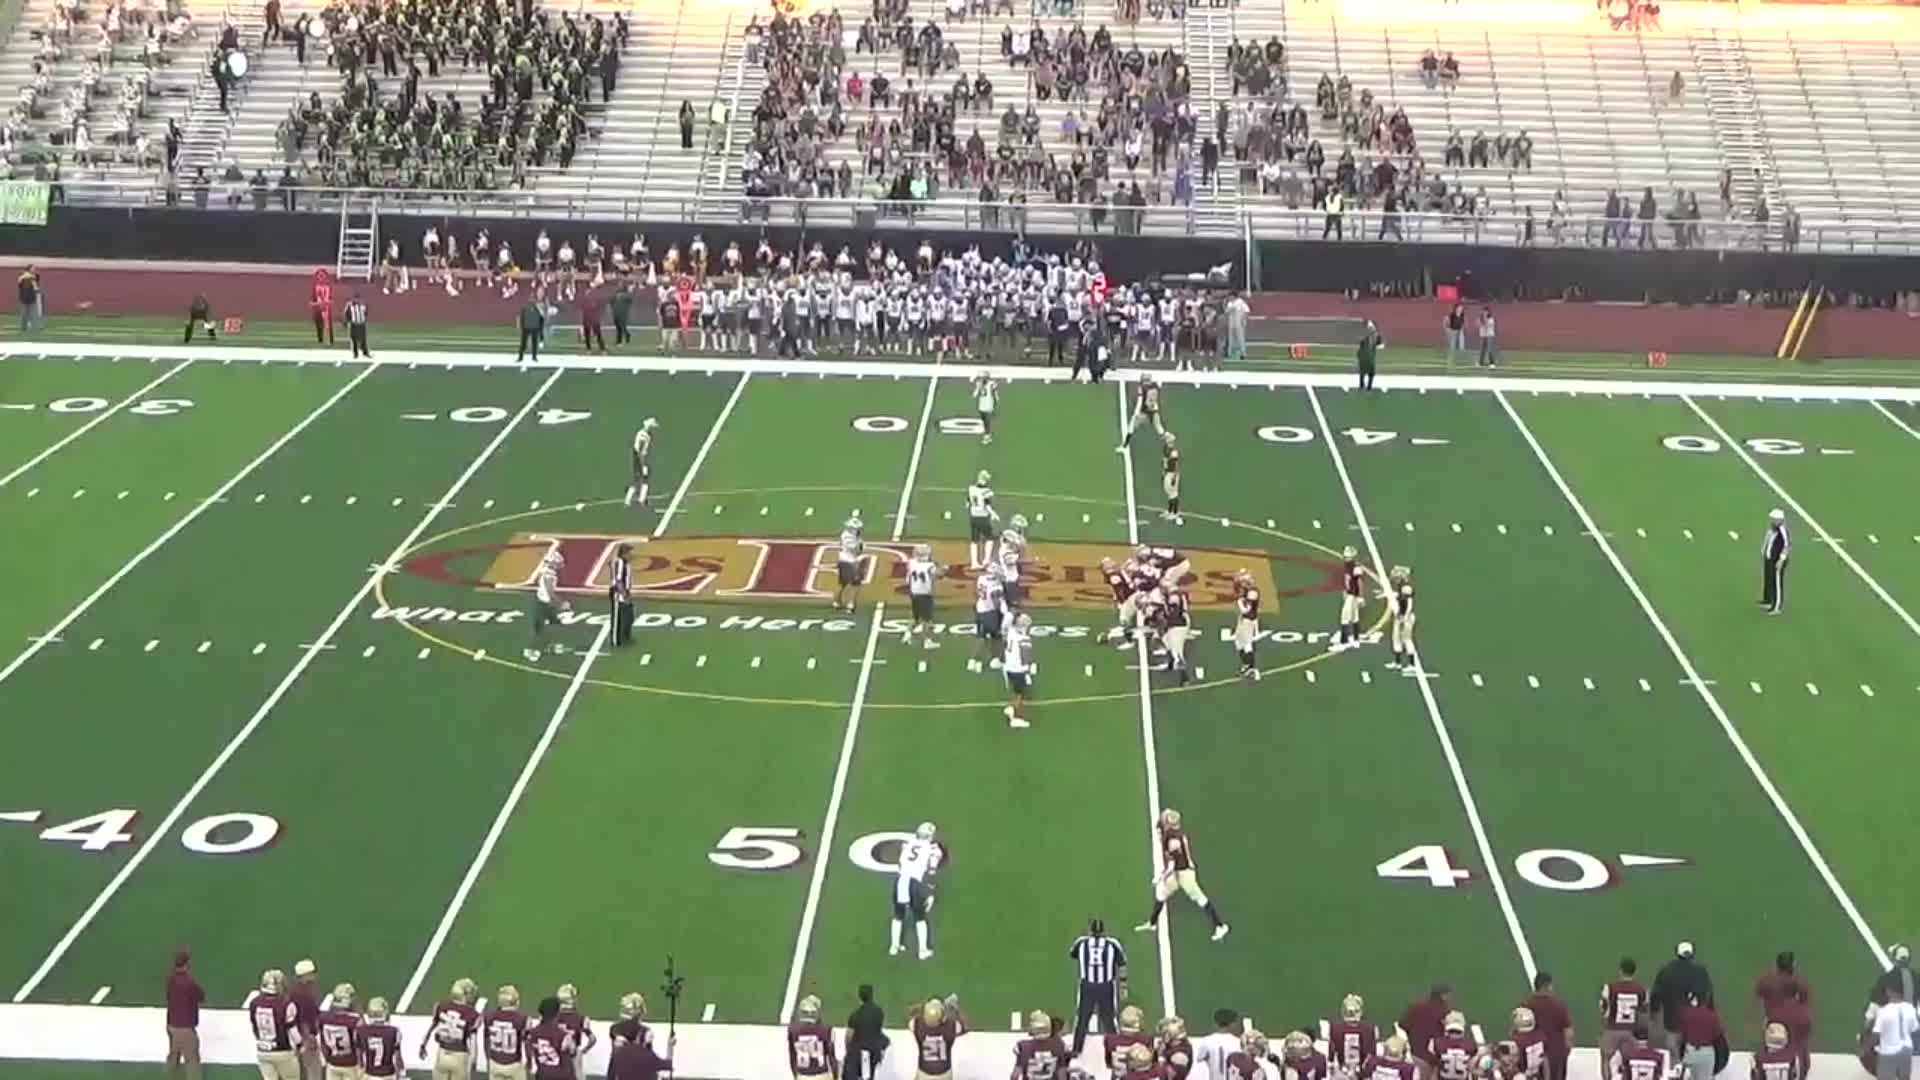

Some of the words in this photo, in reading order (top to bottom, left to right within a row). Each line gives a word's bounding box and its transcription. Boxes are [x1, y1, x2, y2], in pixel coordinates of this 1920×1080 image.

[371, 605, 524, 623] What
[631, 612, 708, 628] Do
[719, 614, 856, 632] Here
[39, 808, 280, 853] 40
[707, 826, 916, 873] 50
[908, 845, 919, 861] 5
[1376, 844, 1611, 890] 40
